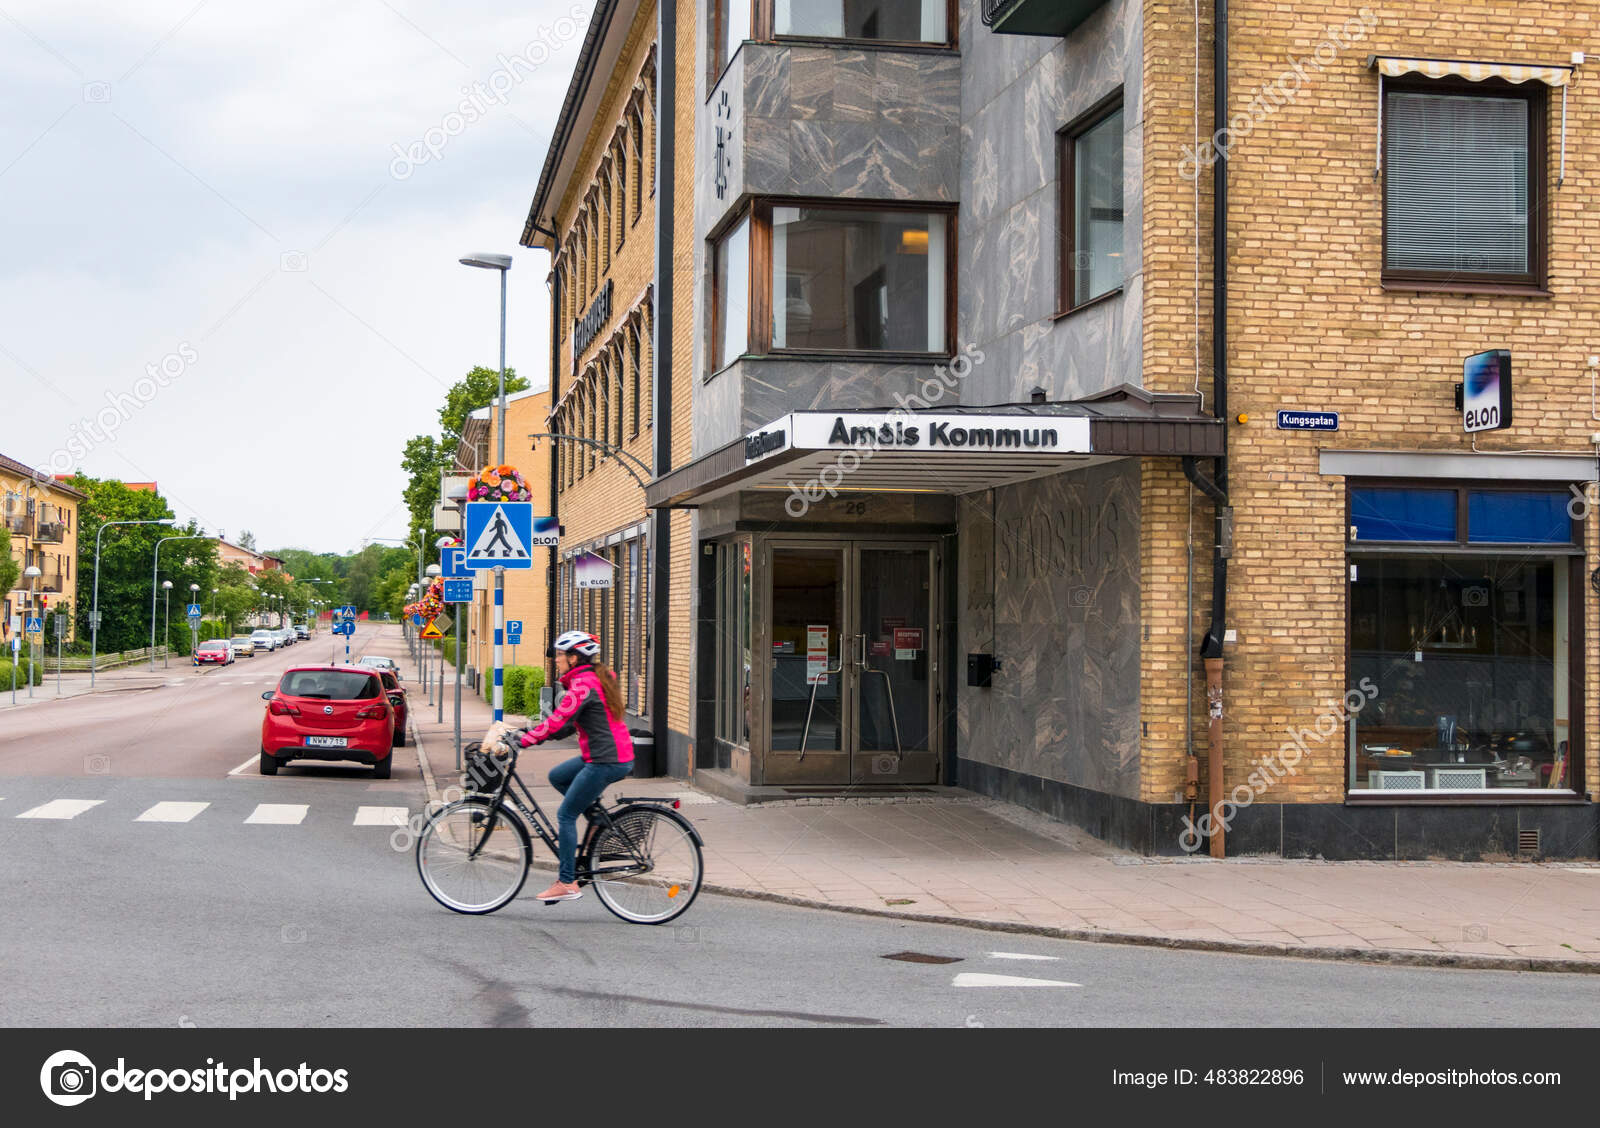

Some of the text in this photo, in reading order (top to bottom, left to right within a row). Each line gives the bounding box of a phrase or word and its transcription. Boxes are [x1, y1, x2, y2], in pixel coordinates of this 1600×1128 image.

[1282, 413, 1334, 427] Kungsgatan
[929, 421, 1058, 448] Kommun
[1000, 502, 1119, 578] STADSHUS
[511, 621, 519, 633] P
[312, 736, 345, 745] NWW 715
